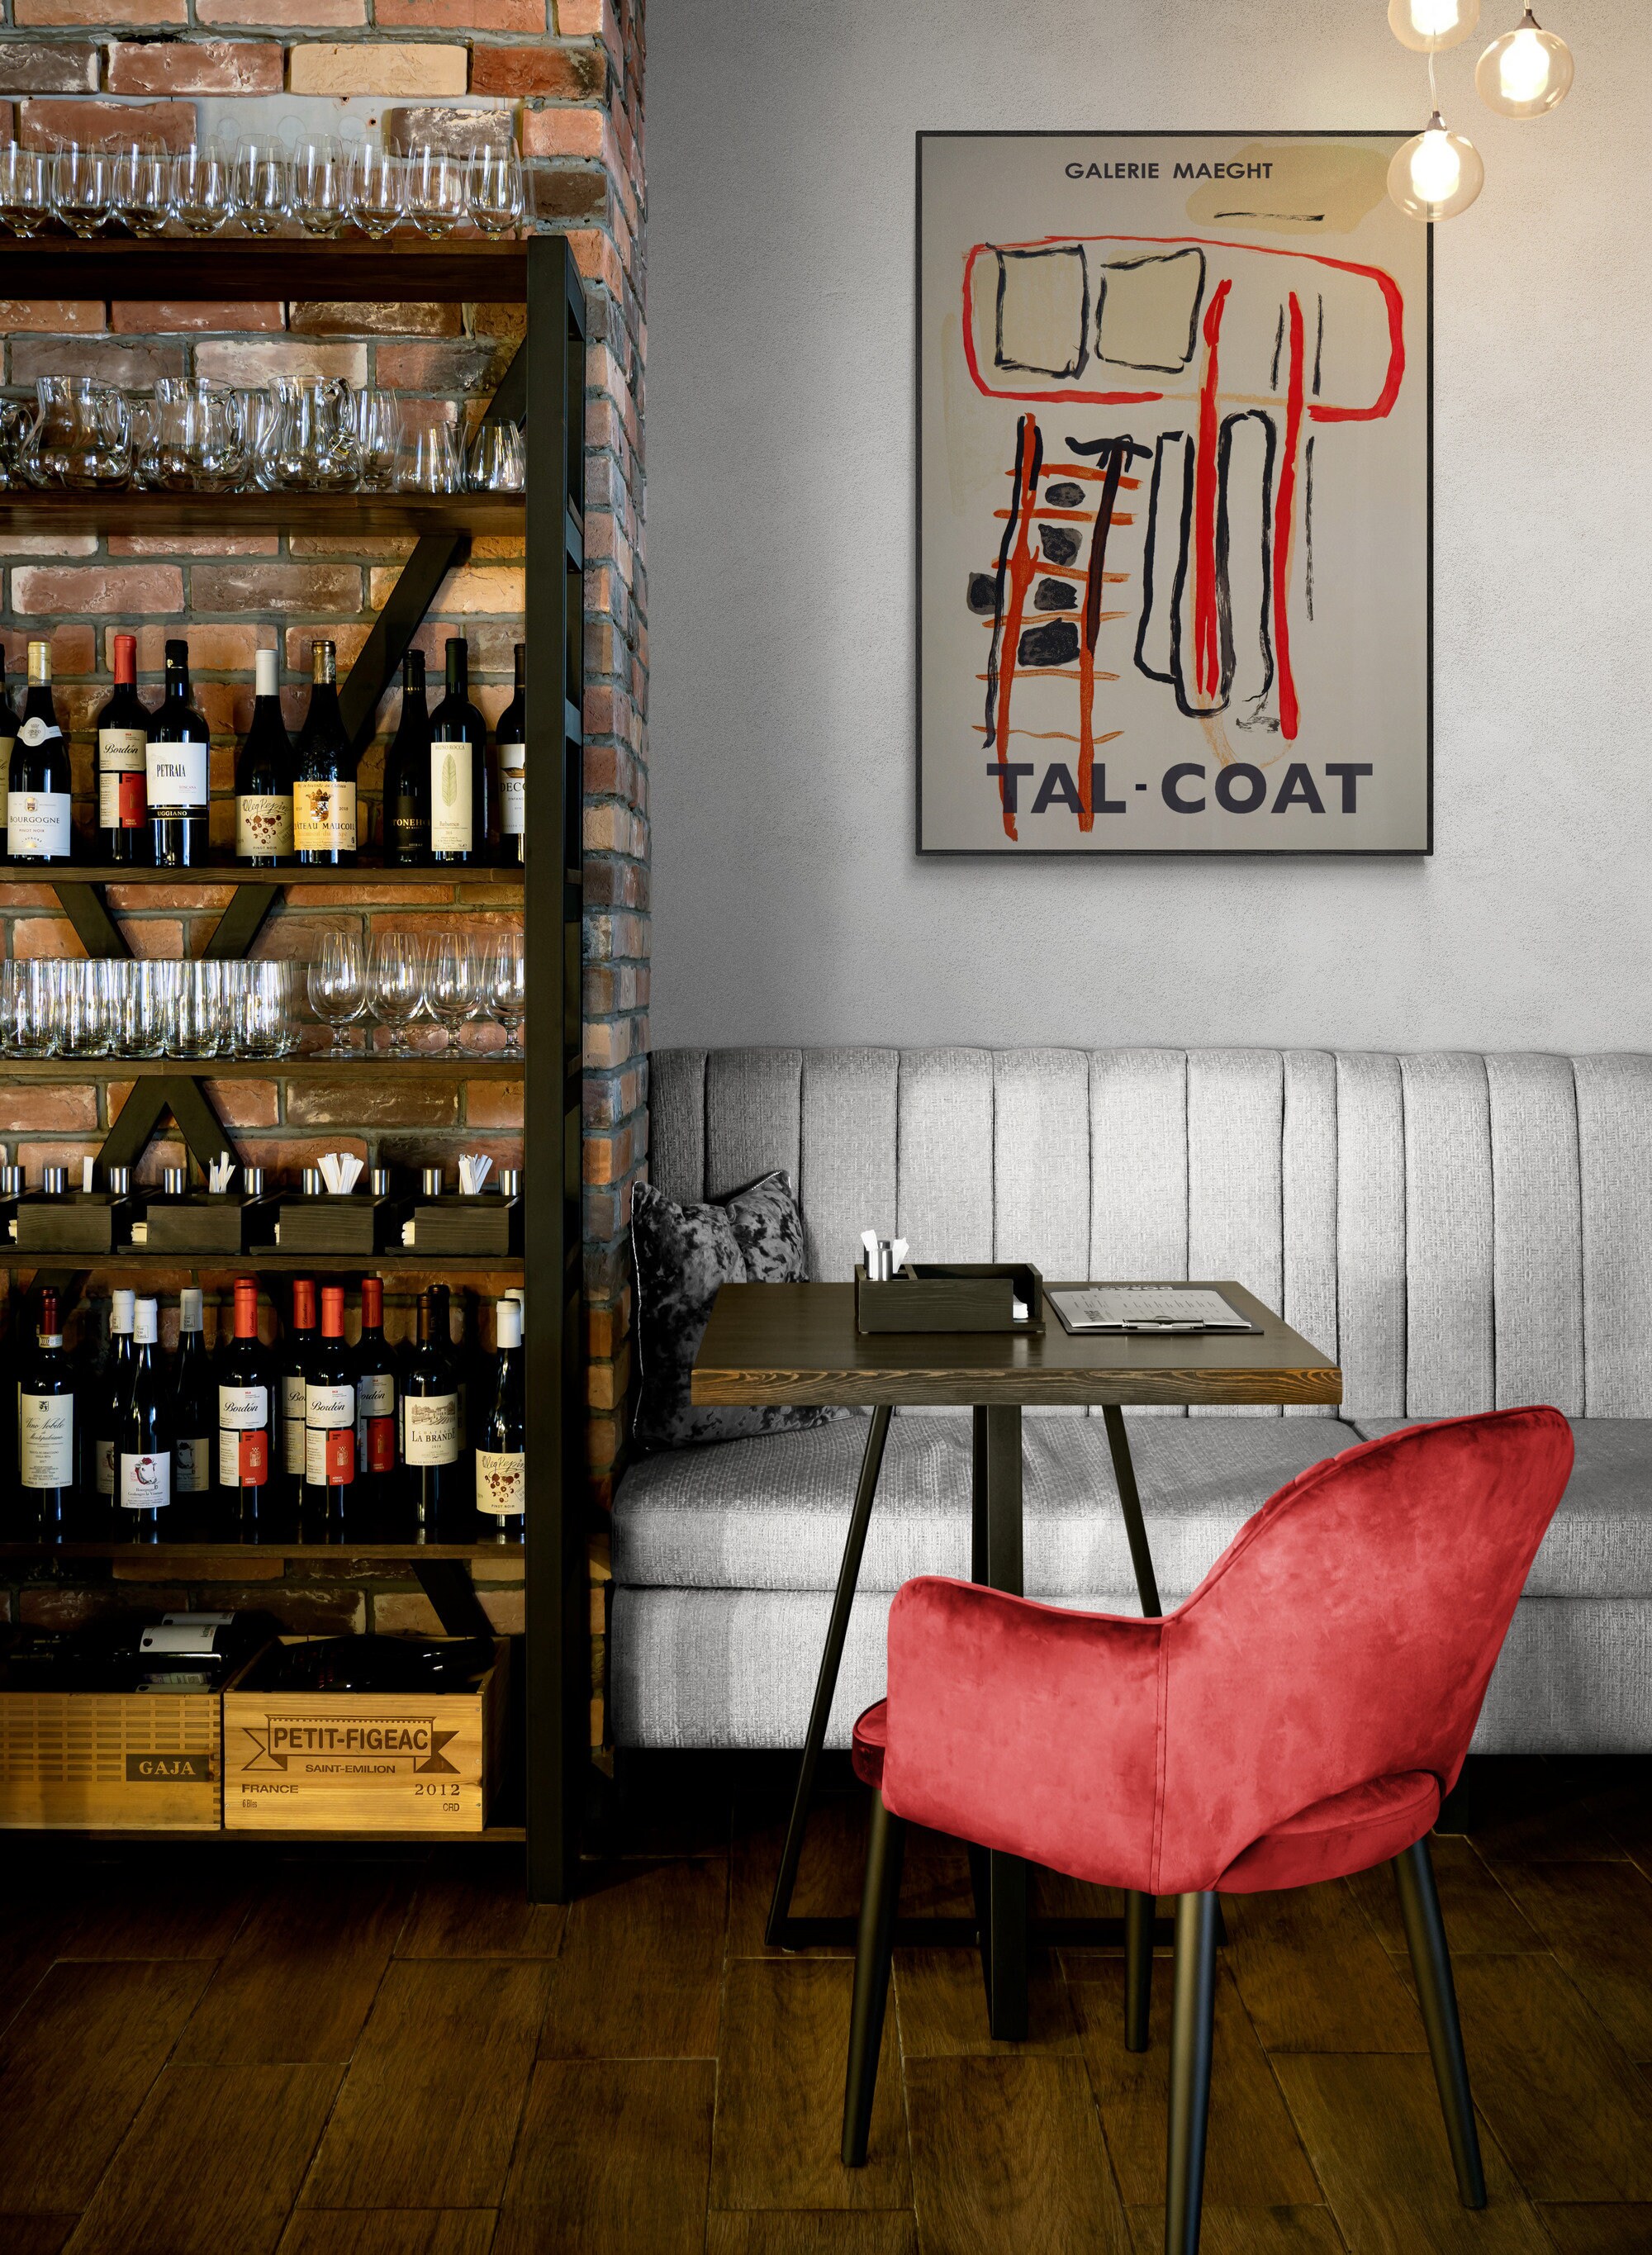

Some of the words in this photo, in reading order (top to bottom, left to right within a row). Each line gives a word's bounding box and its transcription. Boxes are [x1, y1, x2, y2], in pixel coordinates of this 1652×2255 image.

[1065, 162, 1160, 180] GALERIE
[1173, 162, 1274, 180] MAEGHT
[103, 743, 139, 754] Bordón
[156, 764, 186, 777] PETRAIA
[10, 815, 60, 824] BOURGOGNE
[322, 822, 355, 830] MAUCOIL
[361, 1390, 386, 1401] ordón
[224, 1402, 259, 1412] Bordón
[311, 1400, 345, 1412] Bordón
[26, 1417, 40, 1429] Vino
[38, 1417, 66, 1430] Nobile
[412, 1431, 423, 1442] LA
[426, 1427, 456, 1442] BRANDE
[273, 1727, 429, 1751] PETIT-FIGEAC
[139, 1761, 196, 1776] GAJA
[305, 1764, 396, 1774] SAINT-EMILION
[241, 1784, 299, 1794] FRANCE
[415, 1783, 460, 1797] 2012
[242, 1799, 246, 1808] 6
[443, 1802, 460, 1812] CRD
